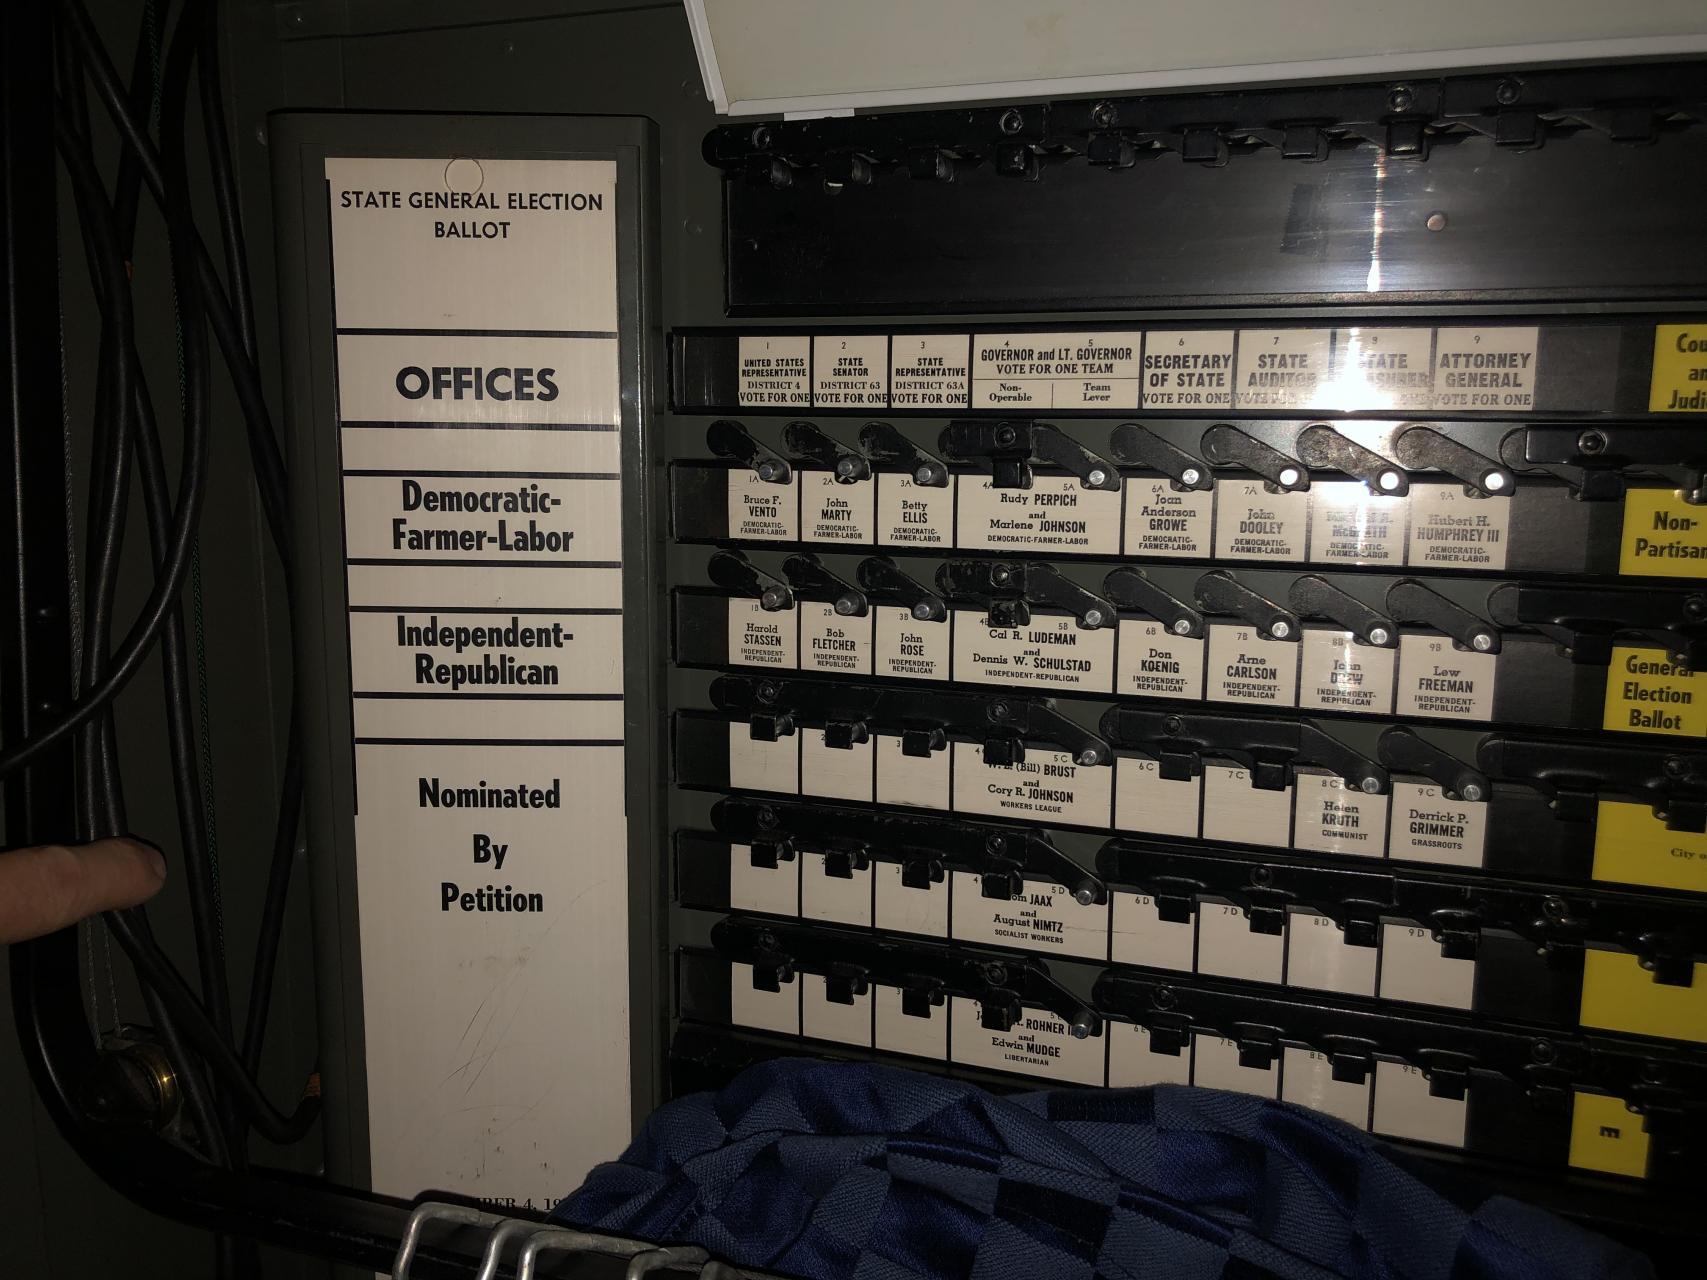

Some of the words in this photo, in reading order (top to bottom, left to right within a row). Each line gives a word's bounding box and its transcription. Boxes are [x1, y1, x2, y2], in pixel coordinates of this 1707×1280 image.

[340, 190, 402, 209] STATE
[408, 191, 499, 210] GENERAL
[507, 193, 603, 211] ELECTION
[434, 221, 510, 239] BALLOT
[981, 349, 1034, 361] GOVERNOR
[1037, 350, 1055, 360] and
[1058, 349, 1073, 360] LT.
[1077, 348, 1132, 360] GOVERNOR
[1440, 352, 1531, 368] ATTORNEY
[744, 359, 771, 367] UNITED
[838, 358, 863, 366] STATE
[917, 358, 943, 366] STATE
[1145, 355, 1231, 369] SECRETARY
[1258, 353, 1308, 368] STATE
[742, 368, 807, 377] REPRESENTATIVE
[833, 368, 869, 376] SENATOR
[896, 368, 966, 376] REPRESENTATIVE
[997, 364, 1025, 374] VOTE
[1029, 364, 1051, 374] FOR
[1055, 364, 1078, 374] ONE
[1081, 364, 1113, 373] TEAM
[395, 366, 559, 402] OFFICES
[748, 381, 792, 390] DISTRICT
[794, 382, 800, 390] 4
[1150, 373, 1168, 387] OF
[1177, 373, 1225, 387] STATE
[1445, 372, 1522, 388] GENERAL
[821, 382, 867, 390] DISTRICT
[870, 382, 880, 390] 63
[896, 382, 944, 390] DISTRICT
[946, 382, 964, 390] 63A
[1000, 383, 1022, 391] Non-
[1083, 383, 1111, 391] Team
[739, 393, 765, 402] VOTE
[768, 394, 788, 402] FOR
[790, 393, 810, 402] ONE
[815, 393, 841, 403] VOTE
[844, 394, 864, 403] FOR
[867, 393, 887, 403] ONE
[892, 394, 918, 403] VOTE
[921, 394, 942, 403] FOR
[945, 394, 968, 403] ONE
[989, 393, 1032, 402] Operable
[1082, 393, 1110, 402] Lever
[1143, 393, 1173, 404] VOTE
[1177, 393, 1201, 404] FOR
[1205, 393, 1230, 404] ONE
[1472, 394, 1500, 405] FOR
[1504, 394, 1531, 405] ONE
[402, 480, 561, 513] Democratic-
[744, 495, 770, 504] Bruce
[1000, 494, 1028, 505] Rudy
[1034, 494, 1077, 506] PERPICH
[1155, 494, 1182, 505] Joan
[827, 498, 848, 508] John
[902, 501, 928, 511] Betty
[749, 507, 777, 517] VENTO
[821, 510, 852, 520] MARTY
[1141, 506, 1196, 517] Anderson
[1248, 508, 1275, 520] John
[903, 512, 928, 523] ELLIS
[1428, 514, 1472, 526] Hubert
[1476, 515, 1490, 526] H.
[1653, 511, 1698, 531] Non-
[743, 521, 784, 529] DEMOCRATIC-
[990, 519, 1033, 530] Marlene
[1039, 521, 1085, 533] JOHNSON
[1150, 519, 1187, 531] GROWE
[1240, 521, 1284, 534] DOOLEY
[392, 518, 574, 553] Farmer-Labor
[741, 527, 787, 535] FARMER-LABOR
[814, 531, 862, 539] FARMER-LABOR
[894, 527, 937, 535] DEMOCRATIC-
[1417, 527, 1484, 542] HUMPHREY
[890, 534, 940, 542] FARMER-LABOR
[988, 535, 1088, 545] DEMOCRATIC-FARMER-LABOR
[1143, 535, 1193, 543] DEMOCRATIC-
[1234, 538, 1286, 547] DEMOCRATIC-
[1139, 543, 1196, 551] FARMER-LABOR
[1230, 546, 1290, 555] FARMER-LABOR
[1430, 545, 1486, 554] DEMOCRATIC-
[1425, 553, 1490, 563] FARMER-LABOR
[746, 623, 778, 633] Harold
[827, 628, 844, 637] Bob
[397, 615, 573, 653] Independent-
[900, 633, 923, 643] John
[989, 629, 1007, 639] Cal
[1013, 632, 1022, 640] R.
[1029, 632, 1076, 645] LUDEMAN
[744, 634, 781, 646] STASSEN
[813, 639, 855, 651] FLETCHER
[741, 648, 785, 656] INDEPENDENT-
[901, 644, 924, 656] ROSE
[1149, 649, 1172, 659] Don
[745, 654, 782, 663] REPUBLICAN
[817, 660, 855, 668] REPUBLICAN
[889, 659, 936, 667] INDEPENDENT-
[973, 654, 1008, 664] Dennis
[1013, 656, 1027, 665] W.
[1033, 658, 1091, 671] SCHULSTAD
[1237, 654, 1266, 665] Arne
[414, 653, 559, 690] Republican
[893, 666, 933, 674] REPUBLICAN
[1141, 660, 1179, 673] KOENIG
[985, 670, 1079, 682] INDEPENDENT-REPUBLICAN
[1227, 666, 1277, 680] CARLSON
[1133, 676, 1188, 685] INDEPENDENT-
[1419, 678, 1473, 693] FREEMAN
[1137, 683, 1183, 692] REPUBLICAN
[1223, 682, 1280, 692] INDEPENDENT-
[1227, 690, 1275, 699] REPUBLICAN
[1623, 682, 1692, 704] Election
[1415, 695, 1475, 705] INDEPENDENT-
[1419, 703, 1470, 713] REPUBLICAN
[1629, 709, 1681, 730] Ballot
[1016, 762, 1040, 773] (Bill)
[1044, 765, 1076, 778] BRUST
[418, 777, 561, 809] Nominated
[988, 784, 1012, 796] Cory
[1015, 787, 1025, 796] R.
[1028, 789, 1073, 803] JOHNSON
[1000, 801, 1032, 810] WORKERS
[1035, 805, 1062, 813] LEAGUE
[1322, 813, 1359, 827] KRUTH
[1409, 809, 1455, 822] Derrick
[1322, 830, 1368, 840] COMMUNIST
[1410, 822, 1464, 838] GRIMMER
[1412, 839, 1462, 850] GRASSROOTS
[472, 833, 508, 869] By
[1671, 848, 1695, 861] City
[441, 882, 544, 912] Petition
[1030, 894, 1052, 907] JAAX
[1020, 910, 1036, 918] and
[994, 914, 1030, 927] August
[1033, 919, 1063, 933] NIMTZ
[995, 929, 1028, 939] SOCIALIST
[1031, 934, 1063, 944] WORKERS
[1026, 1019, 1064, 1035] ROHNER
[1018, 1034, 1035, 1042] and
[992, 1037, 1023, 1050] Edwin
[1027, 1045, 1060, 1057] MUDGE
[1005, 1054, 1049, 1066] LIBERTARIAN
